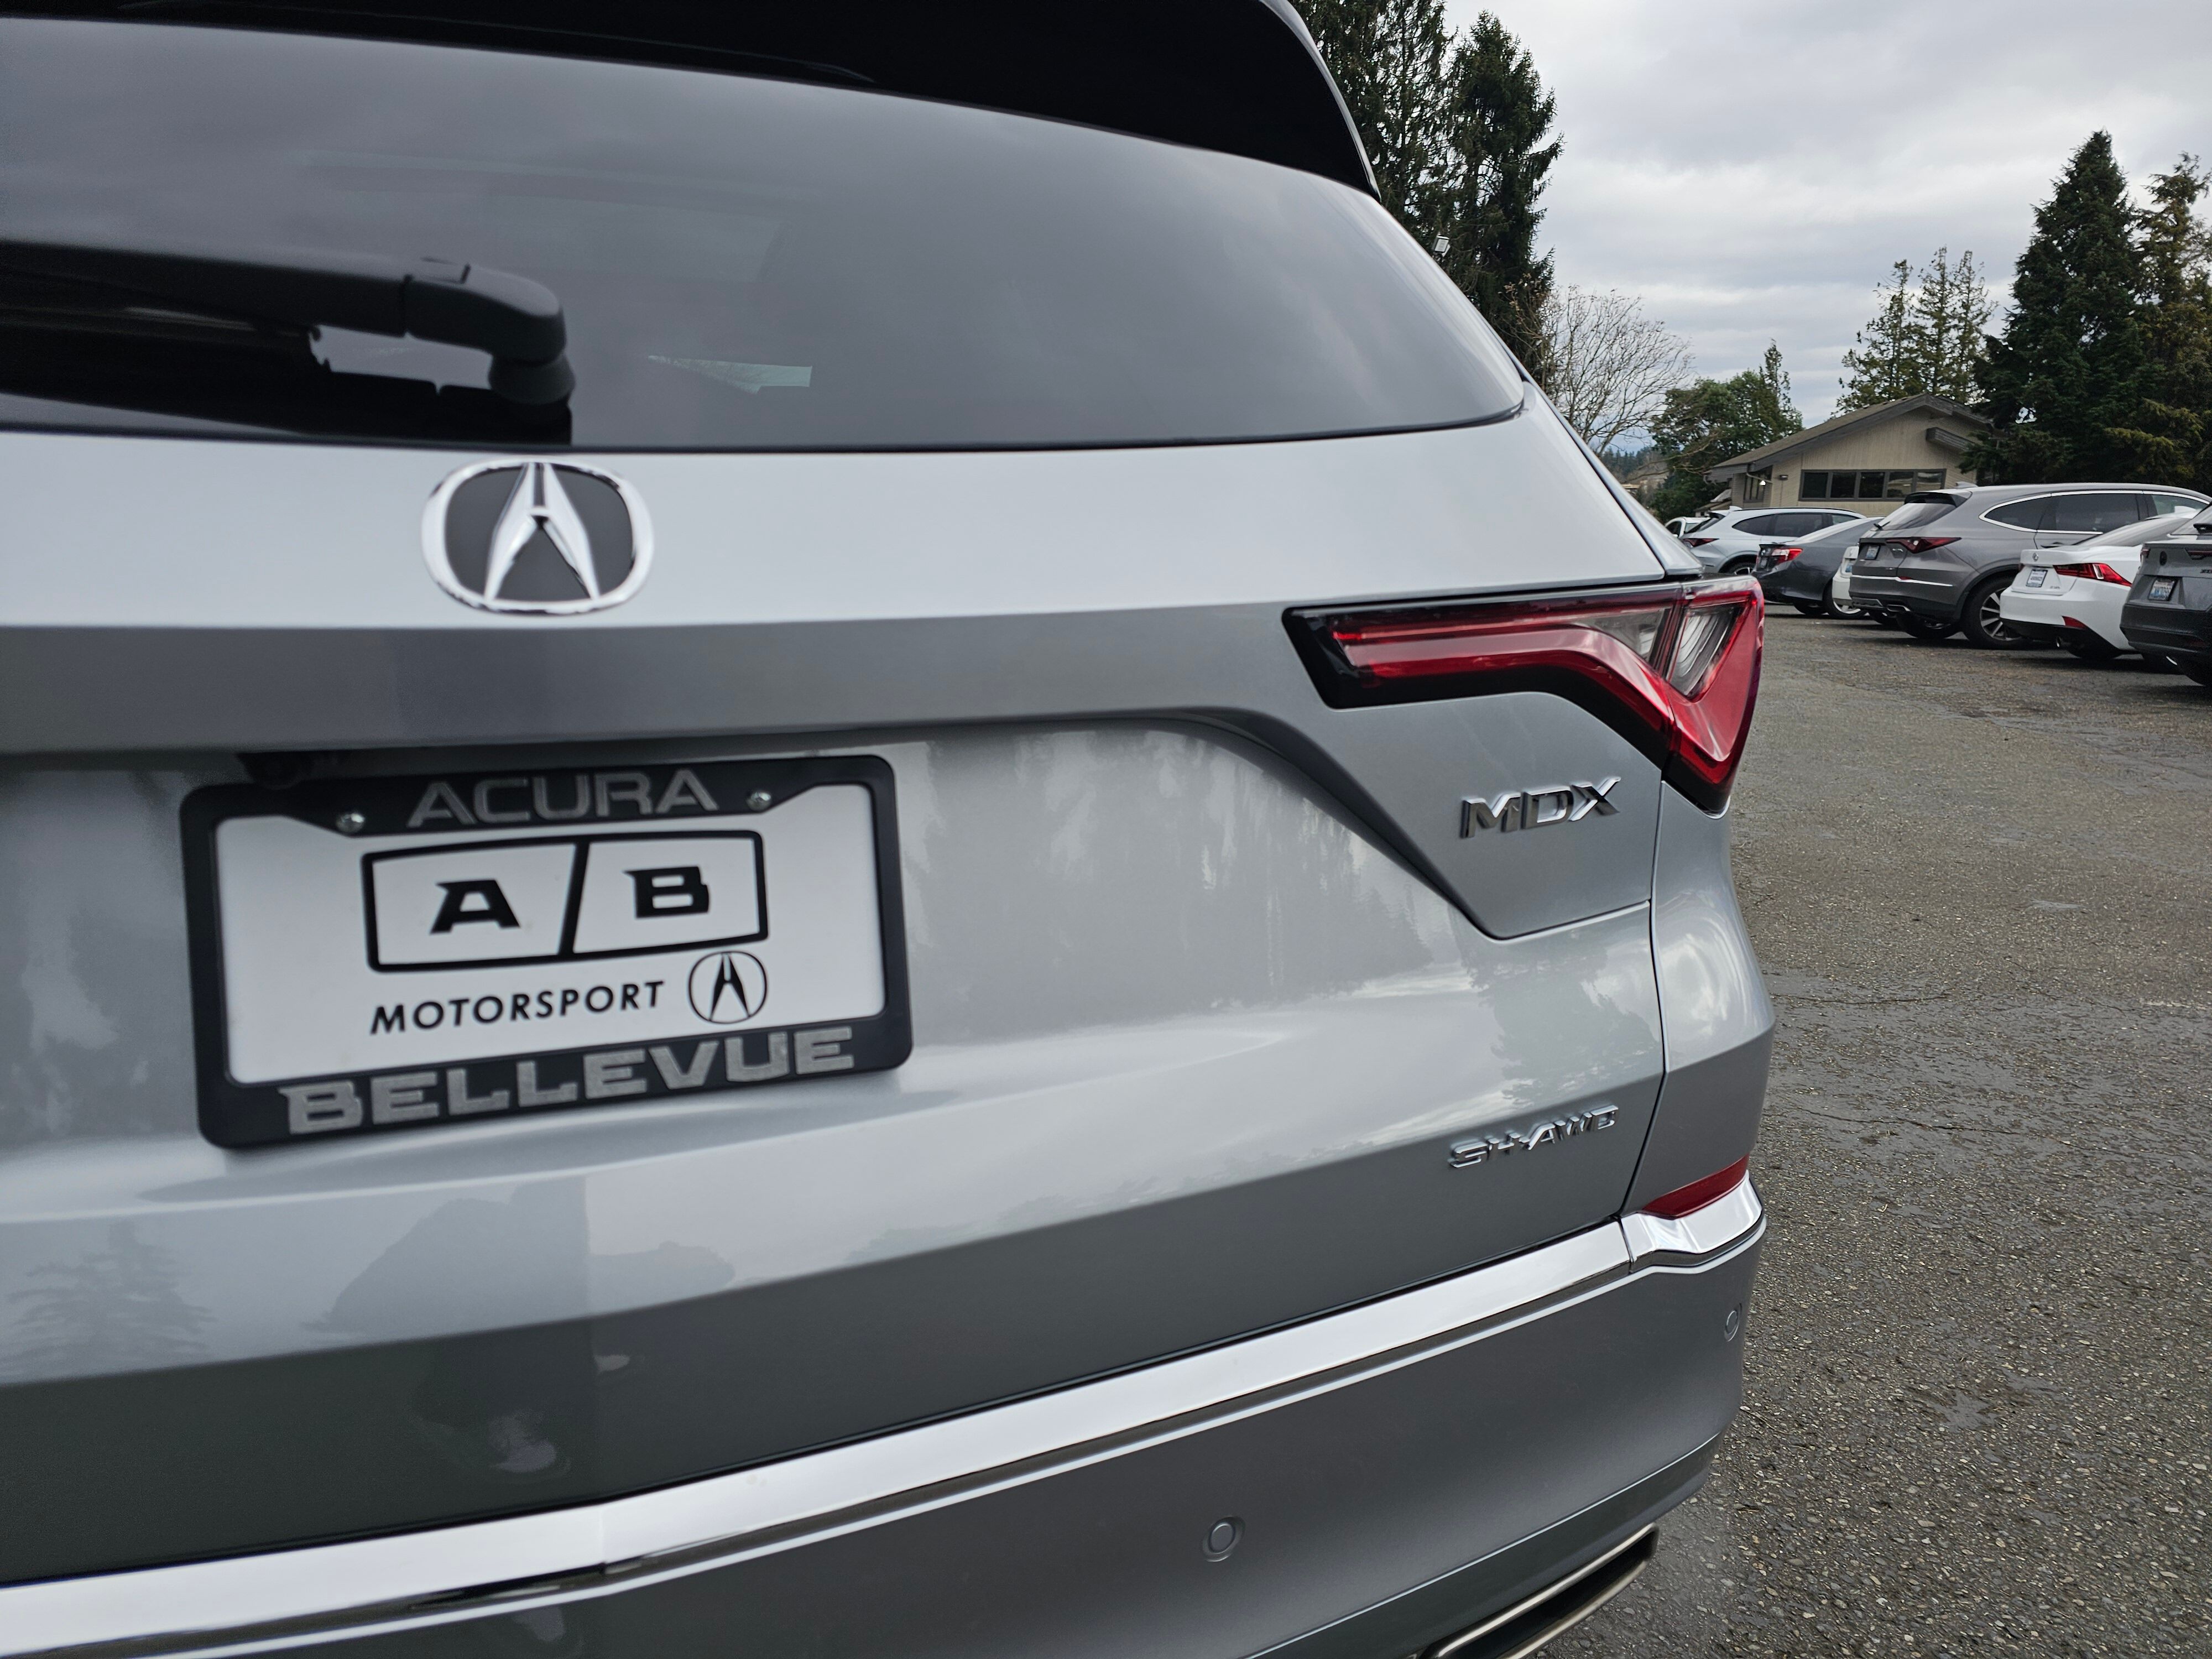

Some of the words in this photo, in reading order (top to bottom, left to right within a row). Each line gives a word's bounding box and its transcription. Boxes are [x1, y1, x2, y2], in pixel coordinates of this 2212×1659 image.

[405, 769, 718, 828] ACURA
[1459, 776, 1621, 839] MDX
[430, 879, 521, 935] A
[623, 865, 710, 919] B
[370, 980, 665, 1036] MOTORSPORT
[278, 1026, 855, 1135] BELLEVUE
[1448, 1105, 1619, 1168] SH-AWD
